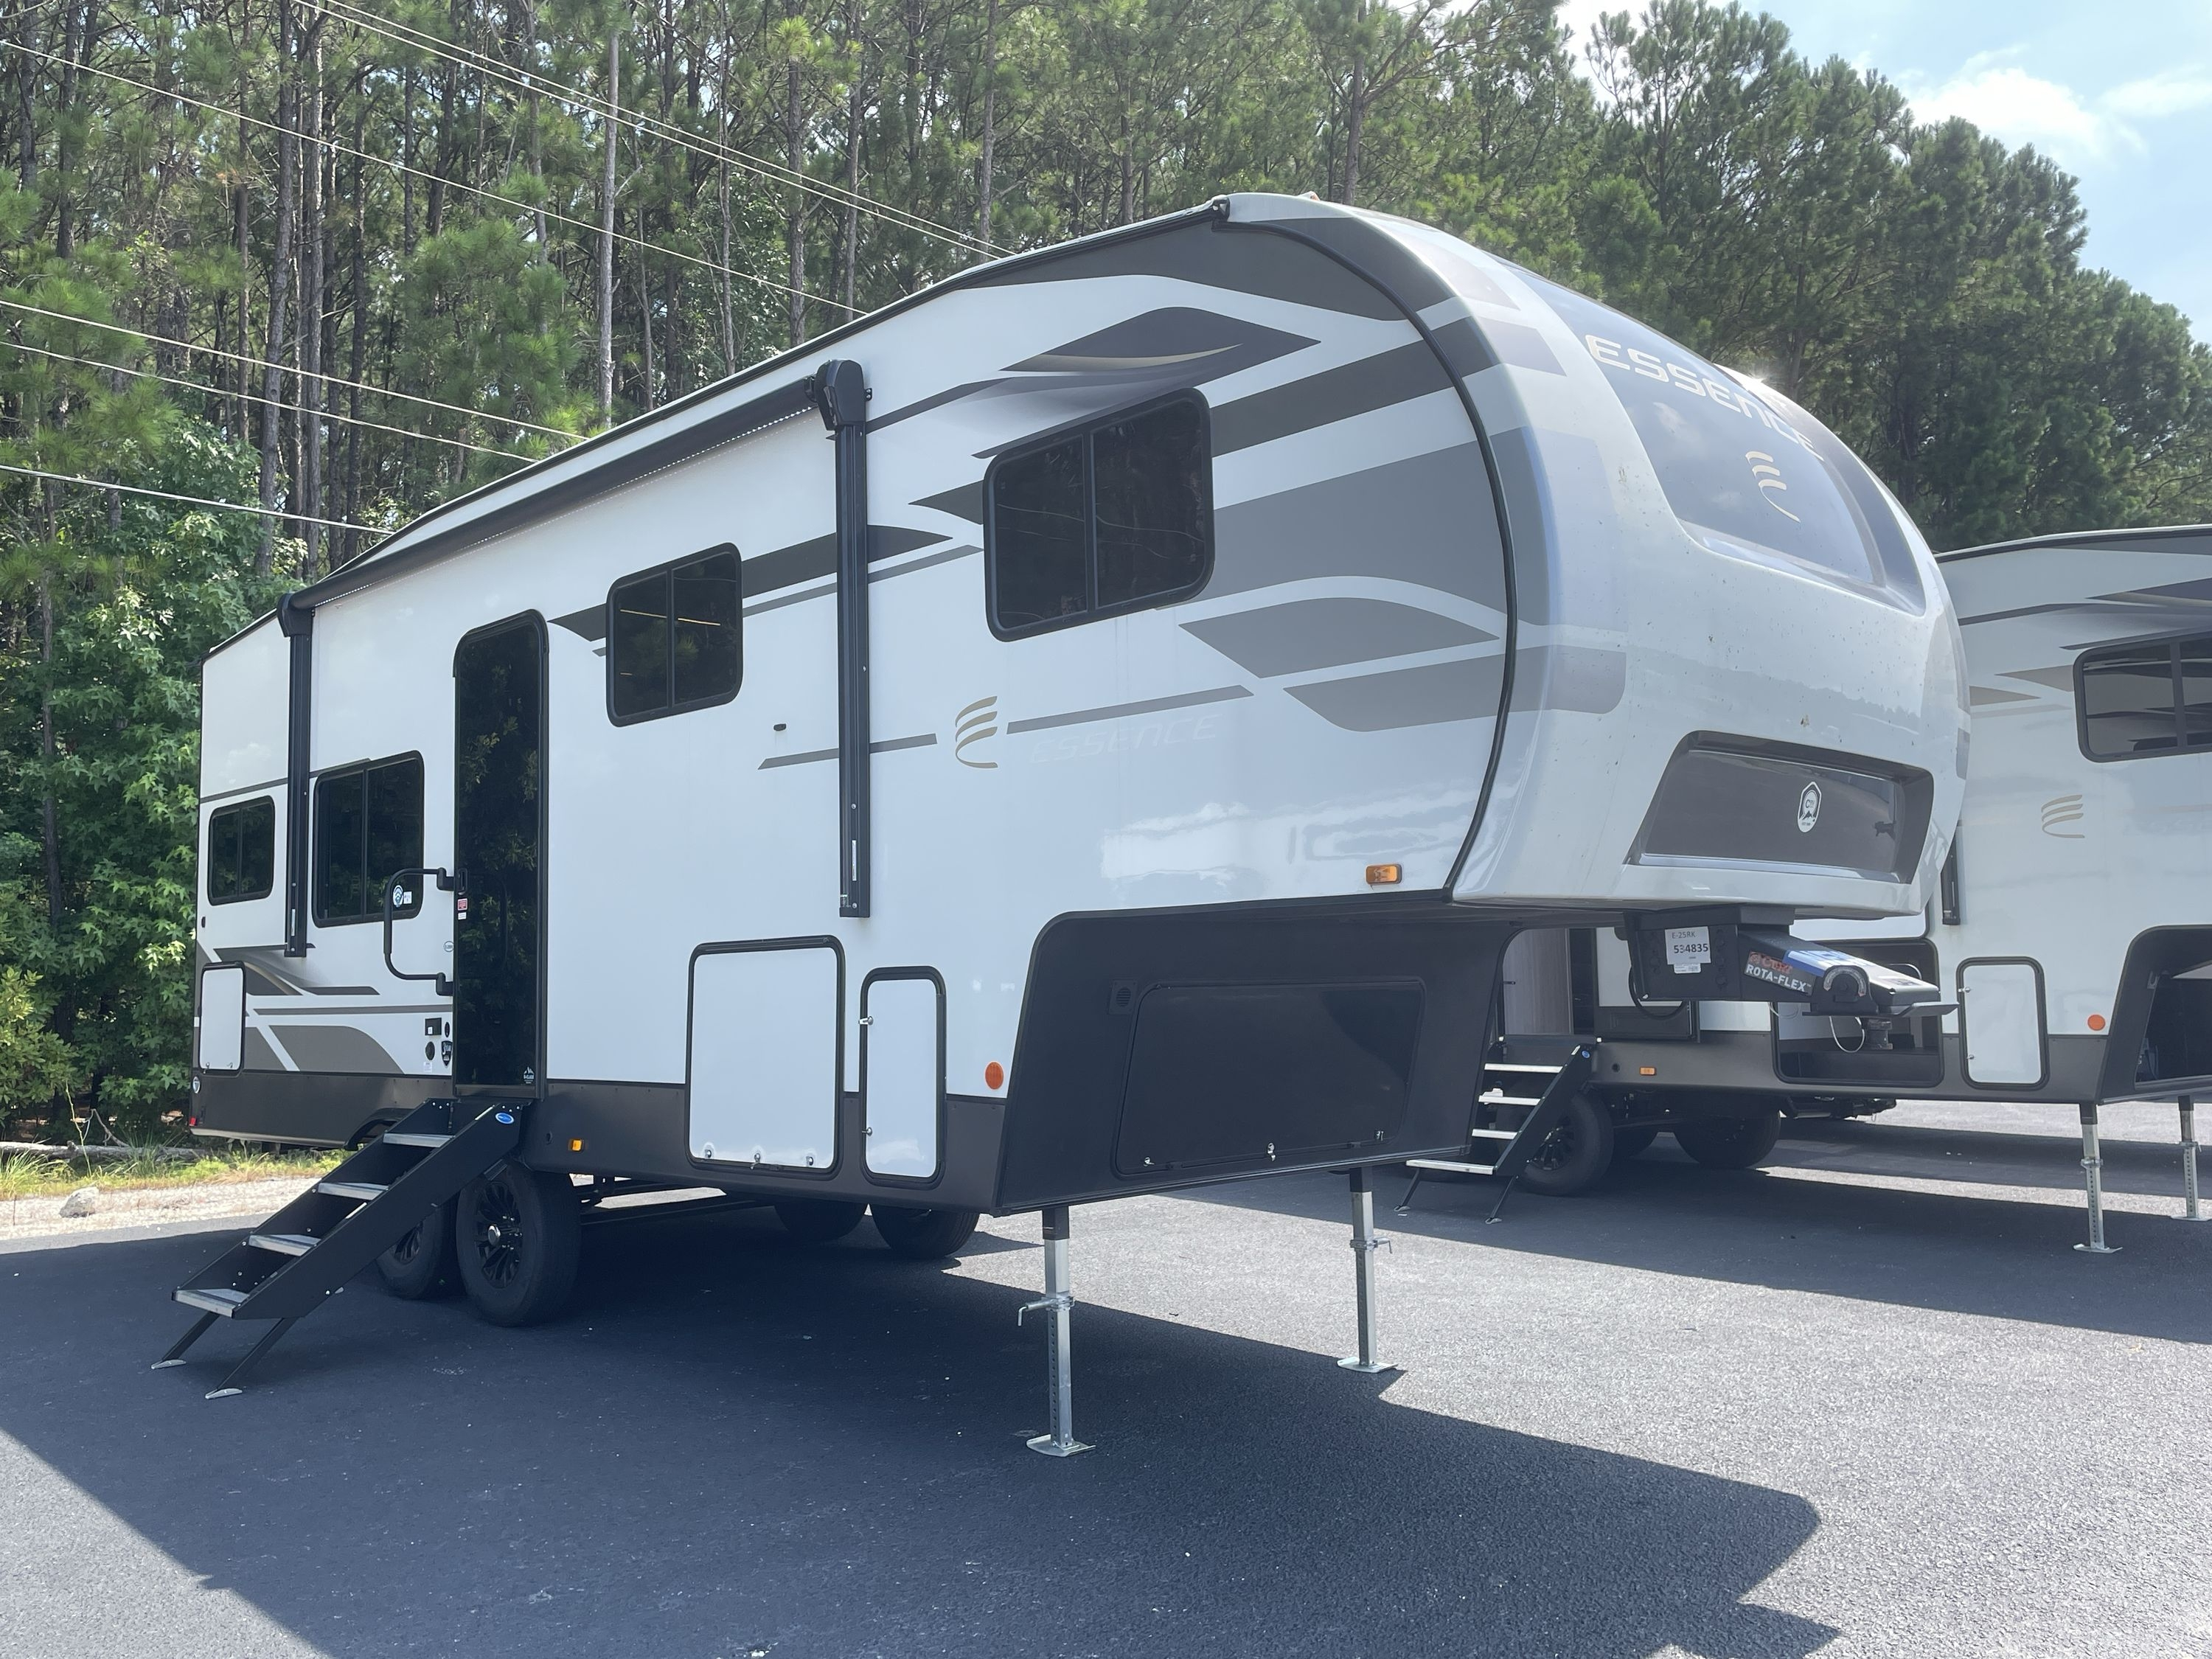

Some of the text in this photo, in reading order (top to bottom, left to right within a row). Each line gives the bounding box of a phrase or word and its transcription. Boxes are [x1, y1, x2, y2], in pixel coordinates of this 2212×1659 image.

[1585, 335, 1824, 462] ESSENCE
[1030, 714, 1223, 763] ESSENCE
[1674, 943, 1708, 953] 534835
